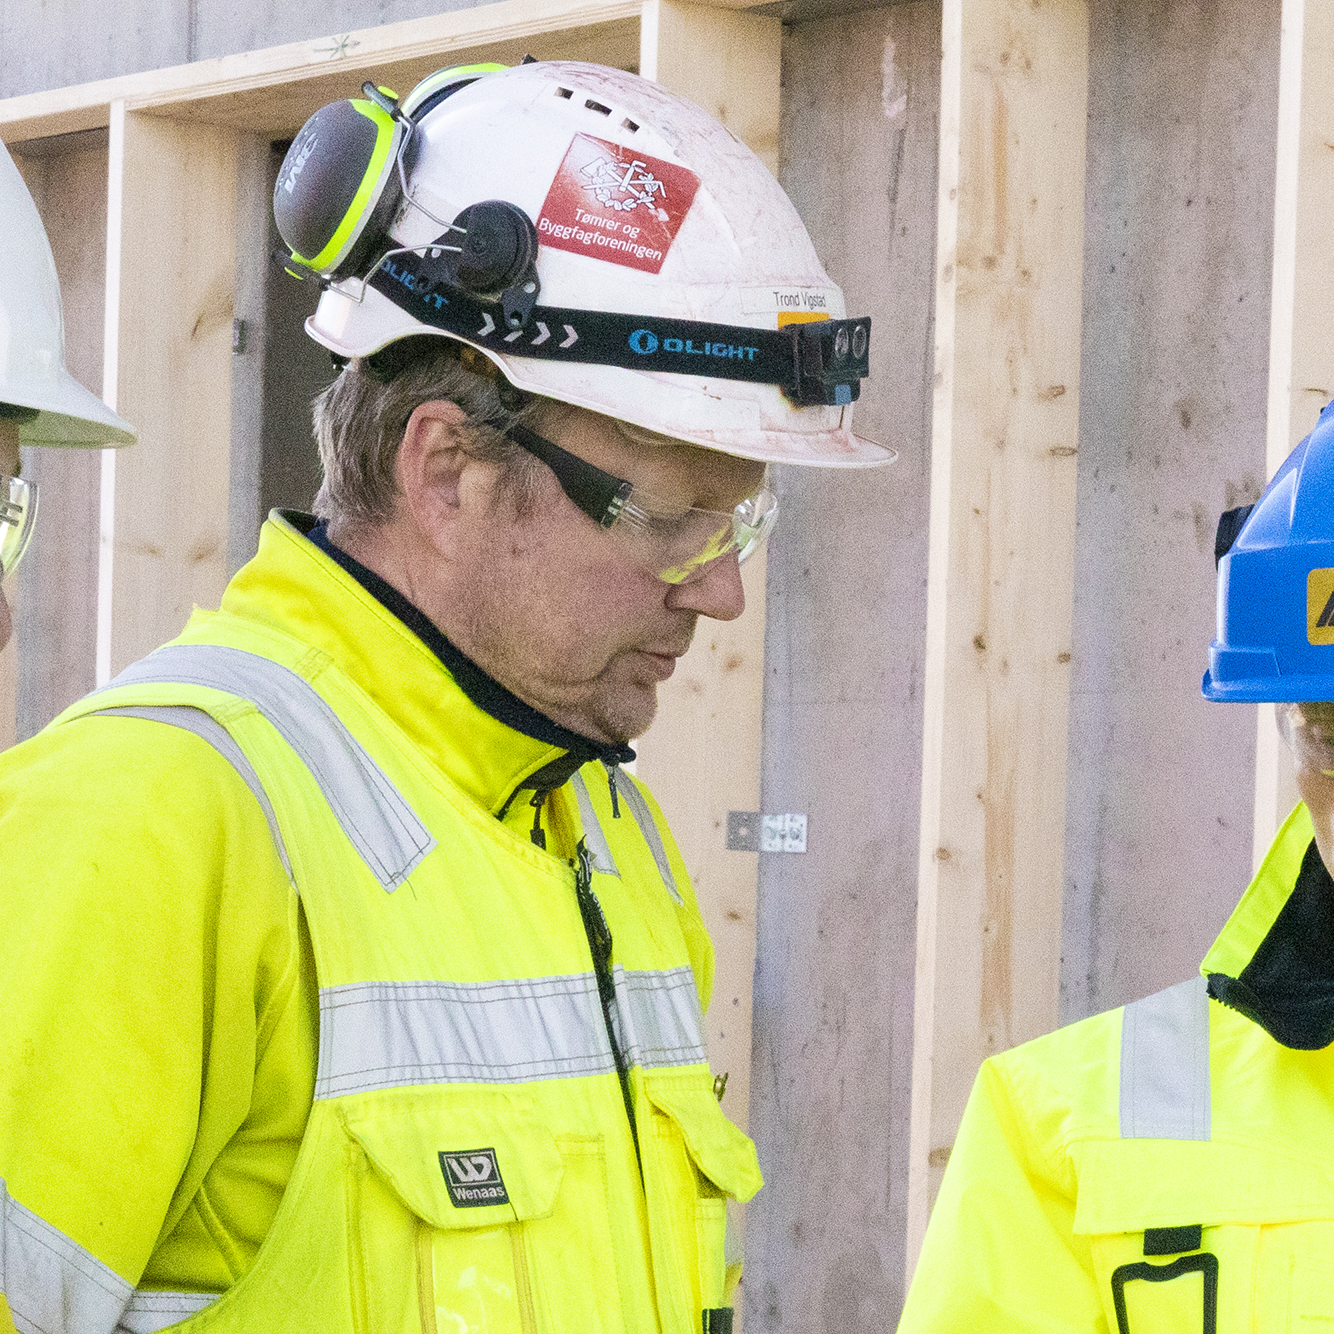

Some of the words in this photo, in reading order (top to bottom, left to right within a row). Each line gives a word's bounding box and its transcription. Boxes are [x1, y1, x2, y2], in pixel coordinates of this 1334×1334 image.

[575, 208, 621, 231] Tømrer
[623, 225, 640, 239] og
[538, 218, 663, 261] Byggfagforeningen
[773, 291, 800, 307] Trond
[663, 338, 759, 361] OLIGHT
[452, 1187, 505, 1201] Wenaas
